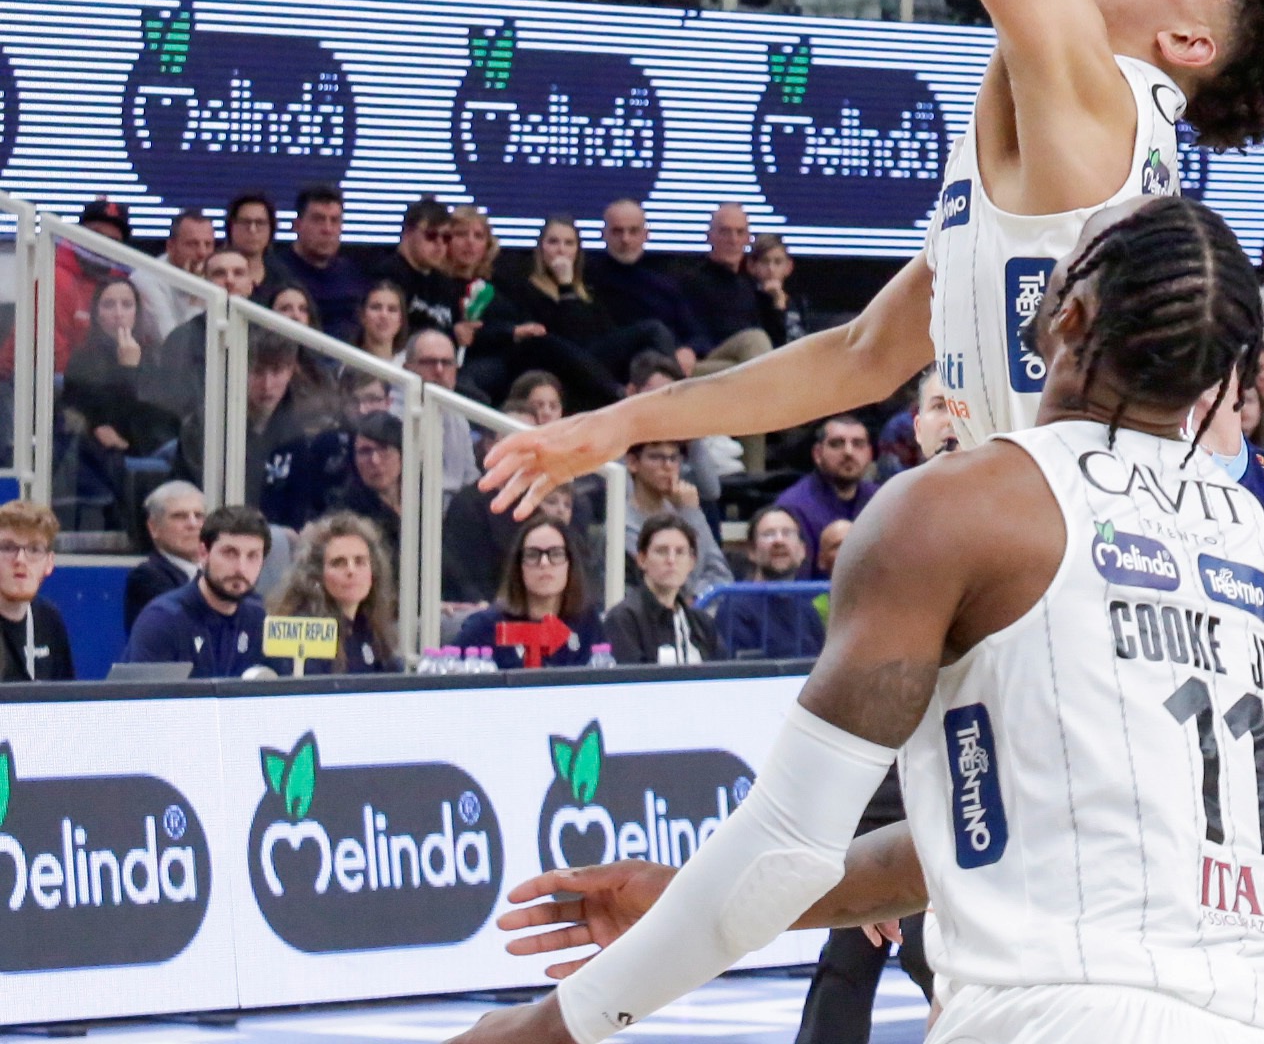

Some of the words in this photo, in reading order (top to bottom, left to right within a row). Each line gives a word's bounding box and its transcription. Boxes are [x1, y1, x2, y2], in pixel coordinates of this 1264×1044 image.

[1078, 450, 1243, 524] CAVIT
[1142, 517, 1218, 546] TRENTO
[1095, 541, 1178, 579] Melinda
[1204, 568, 1264, 607] TRENTINO
[268, 621, 303, 640] INSTANT
[305, 622, 335, 641] REPLAY
[1109, 600, 1228, 676] COOKE
[956, 720, 991, 852] TRENTINO
[260, 801, 491, 897] Melinda
